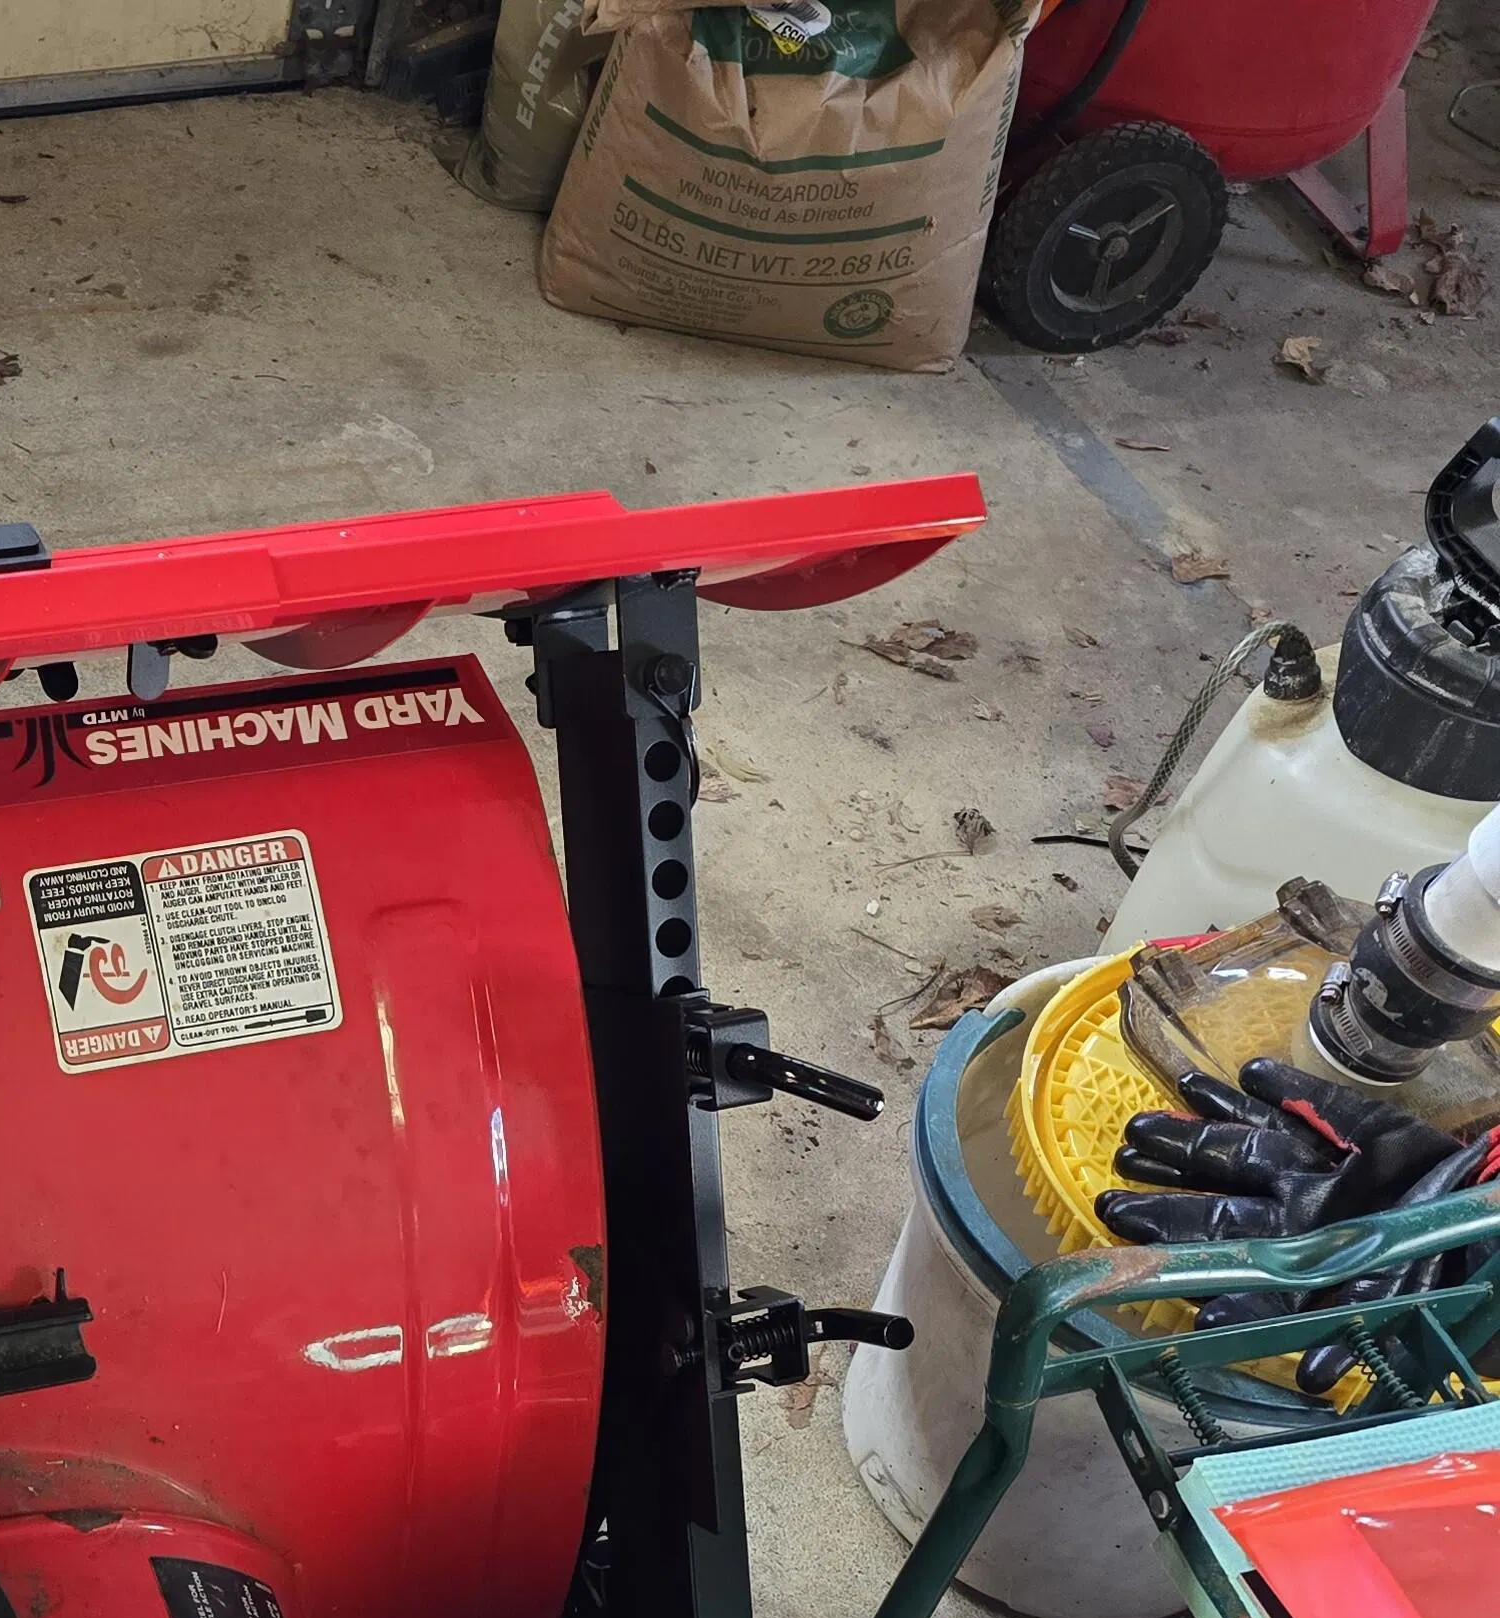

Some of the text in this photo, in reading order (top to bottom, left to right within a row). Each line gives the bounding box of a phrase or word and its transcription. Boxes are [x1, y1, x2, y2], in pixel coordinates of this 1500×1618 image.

[701, 165, 860, 203] NON-HAZARDOUS
[679, 178, 875, 224] When Used As Directed
[613, 202, 638, 233] 50
[642, 218, 688, 258] LBS.
[696, 242, 750, 272] NET
[750, 253, 795, 278] WT.
[803, 252, 872, 278] 22.68
[876, 246, 916, 273] KG.
[81, 705, 147, 725] by MTD
[85, 686, 484, 765] YARD MACHINES
[180, 839, 288, 874] DANGER
[64, 867, 108, 882] CLOTHING
[109, 864, 128, 876] AND
[158, 880, 177, 891] KEEP
[178, 876, 200, 888] AWAY
[202, 873, 224, 884] FROM
[224, 867, 262, 881] ROTATING
[262, 861, 300, 875] IMPELLER
[38, 876, 130, 899] KEEP HANDS, FEET
[159, 889, 175, 899] AND
[204, 880, 237, 893] CONTACT
[237, 877, 256, 888] WITH
[255, 872, 290, 885] IMPELLER
[290, 870, 301, 879] OR
[161, 878, 306, 909] AUGER CAN AMPUTATE HANDS AND FEET.
[43, 899, 135, 922] AVOID INJURY FROM
[46, 887, 133, 909] ROTATING AUGER
[155, 894, 287, 922] 2. USE CLEAN-OUT TOOL TO UNCLOG
[166, 910, 237, 930] DISCHARGE CHUTE.
[168, 929, 208, 943] DISENGAGE
[208, 924, 236, 937] CLUTCH
[265, 917, 284, 928] STOP
[170, 922, 313, 952] AND REMAIN BEHIND HANDLES UNTIL ALL
[172, 931, 314, 961] MOVING PARTS HAVE STOPPED BEFORE
[173, 954, 225, 970] UNCLOGGING
[225, 952, 237, 962] OR
[238, 945, 279, 960] SERVICING
[176, 959, 282, 984] TO AVOID THROWN OBJECTS
[178, 970, 275, 993] NEVER DIRECT DISCHARGE AT
[179, 971, 321, 1001] USE EXTRA CAUTION WHEN OPERATING ON
[181, 991, 258, 1011] GRAVEL SURFACES.
[184, 1012, 206, 1024] READ
[207, 1004, 257, 1020] OPERATOR'S
[259, 998, 296, 1012] MANUAL.
[64, 1028, 141, 1057] DANGER
[179, 1024, 238, 1040] CLEAN-OUT TOOL
[187, 1584, 200, 1602] FOR
[191, 1571, 209, 1603] ACTION
